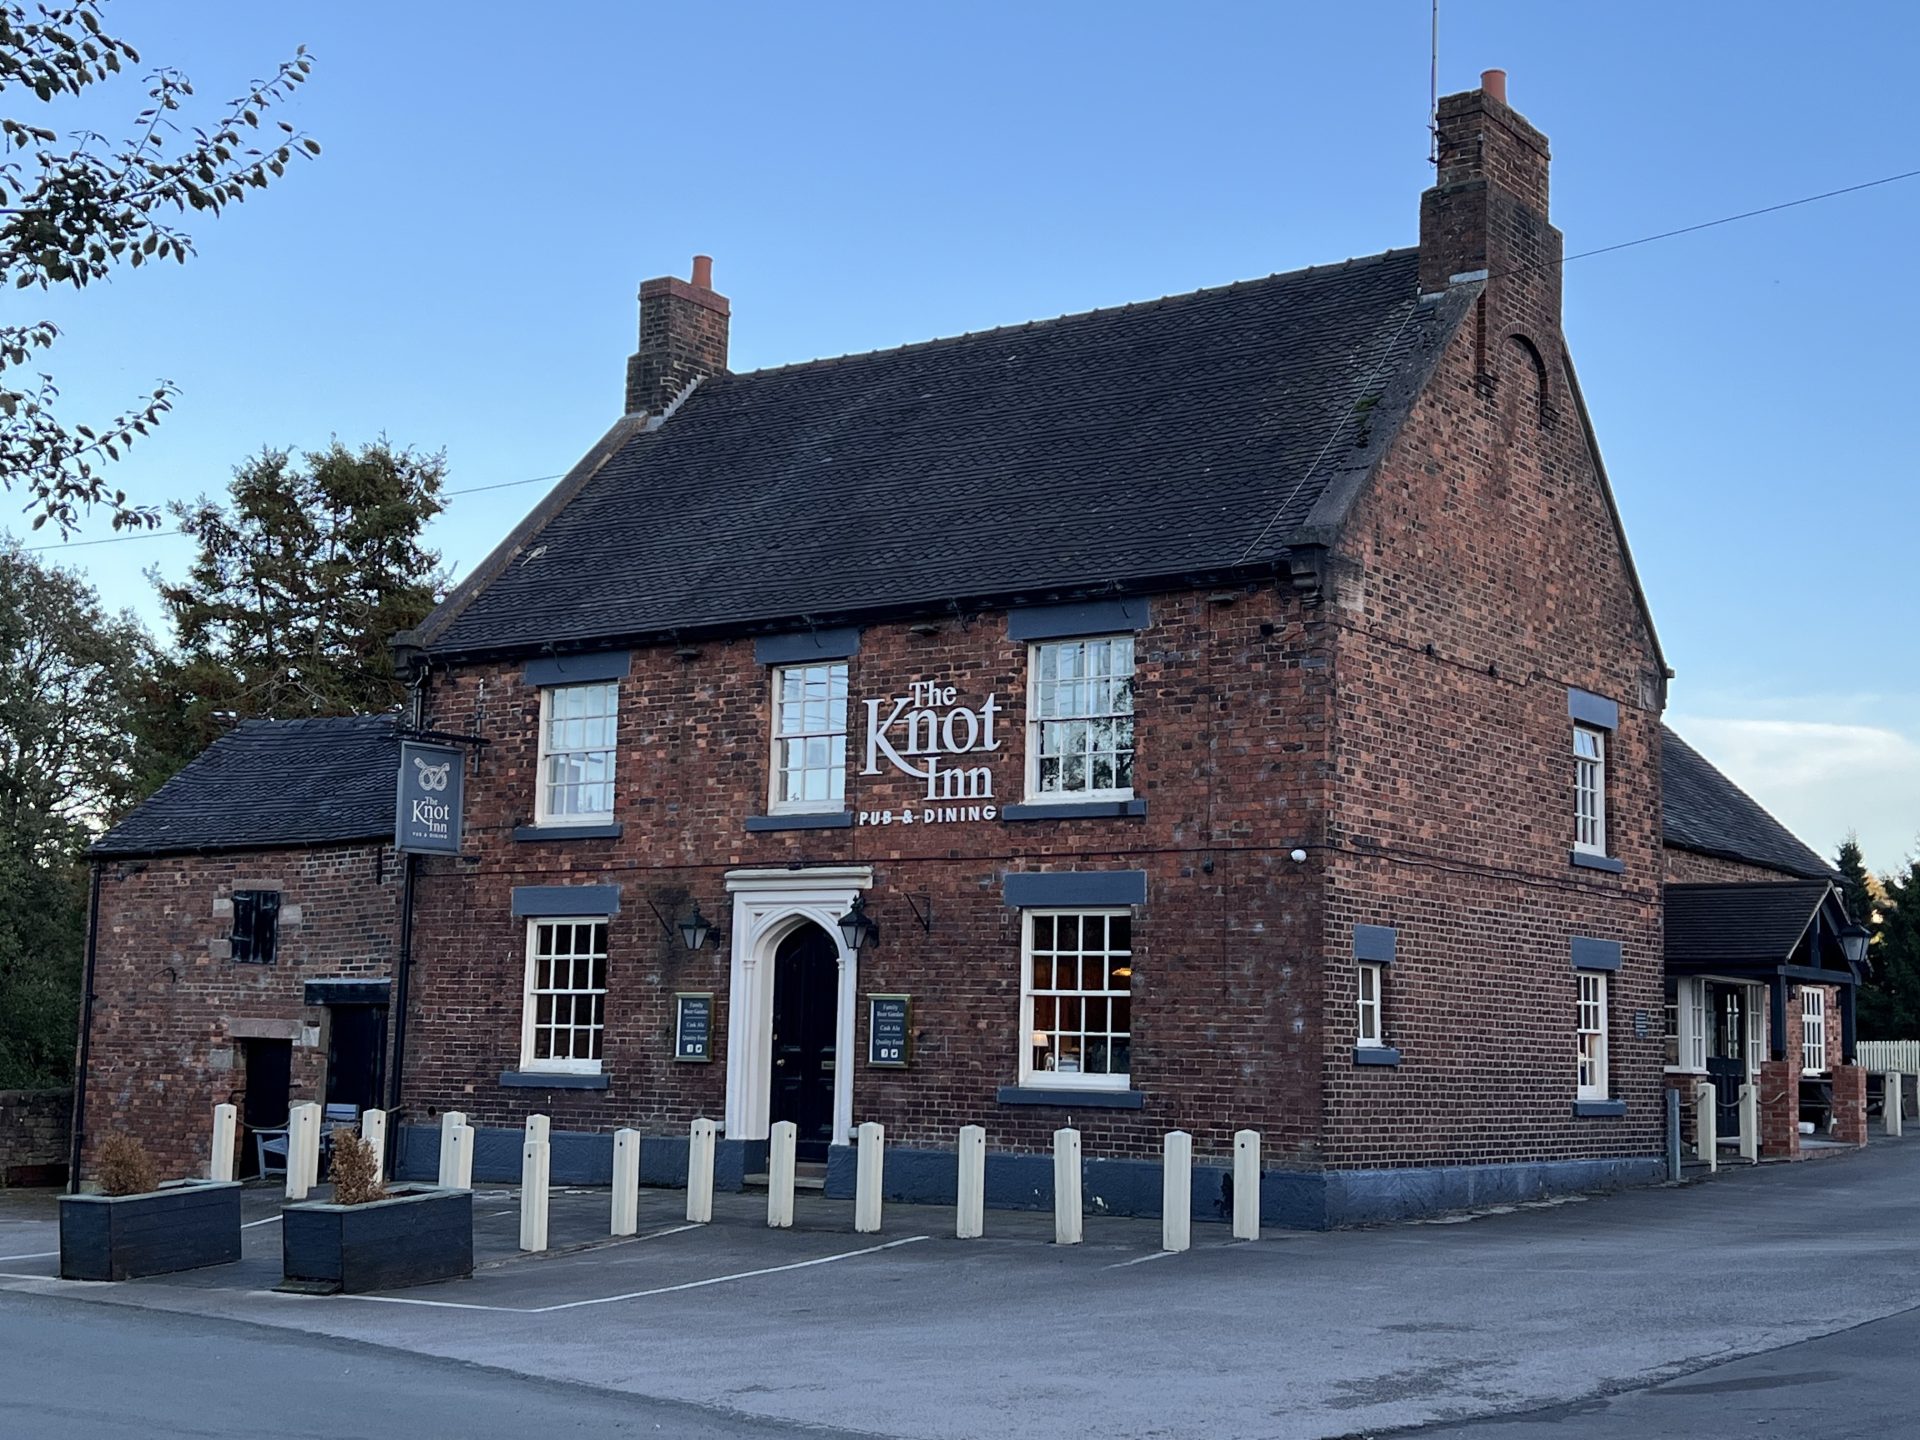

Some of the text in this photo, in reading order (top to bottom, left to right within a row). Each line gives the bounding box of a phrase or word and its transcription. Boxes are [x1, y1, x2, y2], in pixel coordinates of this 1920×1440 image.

[909, 680, 957, 708] The
[859, 693, 1002, 778] Knot
[922, 757, 995, 800] Inn
[411, 800, 449, 825] Knot
[425, 796, 438, 805] The
[429, 819, 448, 833] Inn
[859, 805, 997, 826] PUB & DINING
